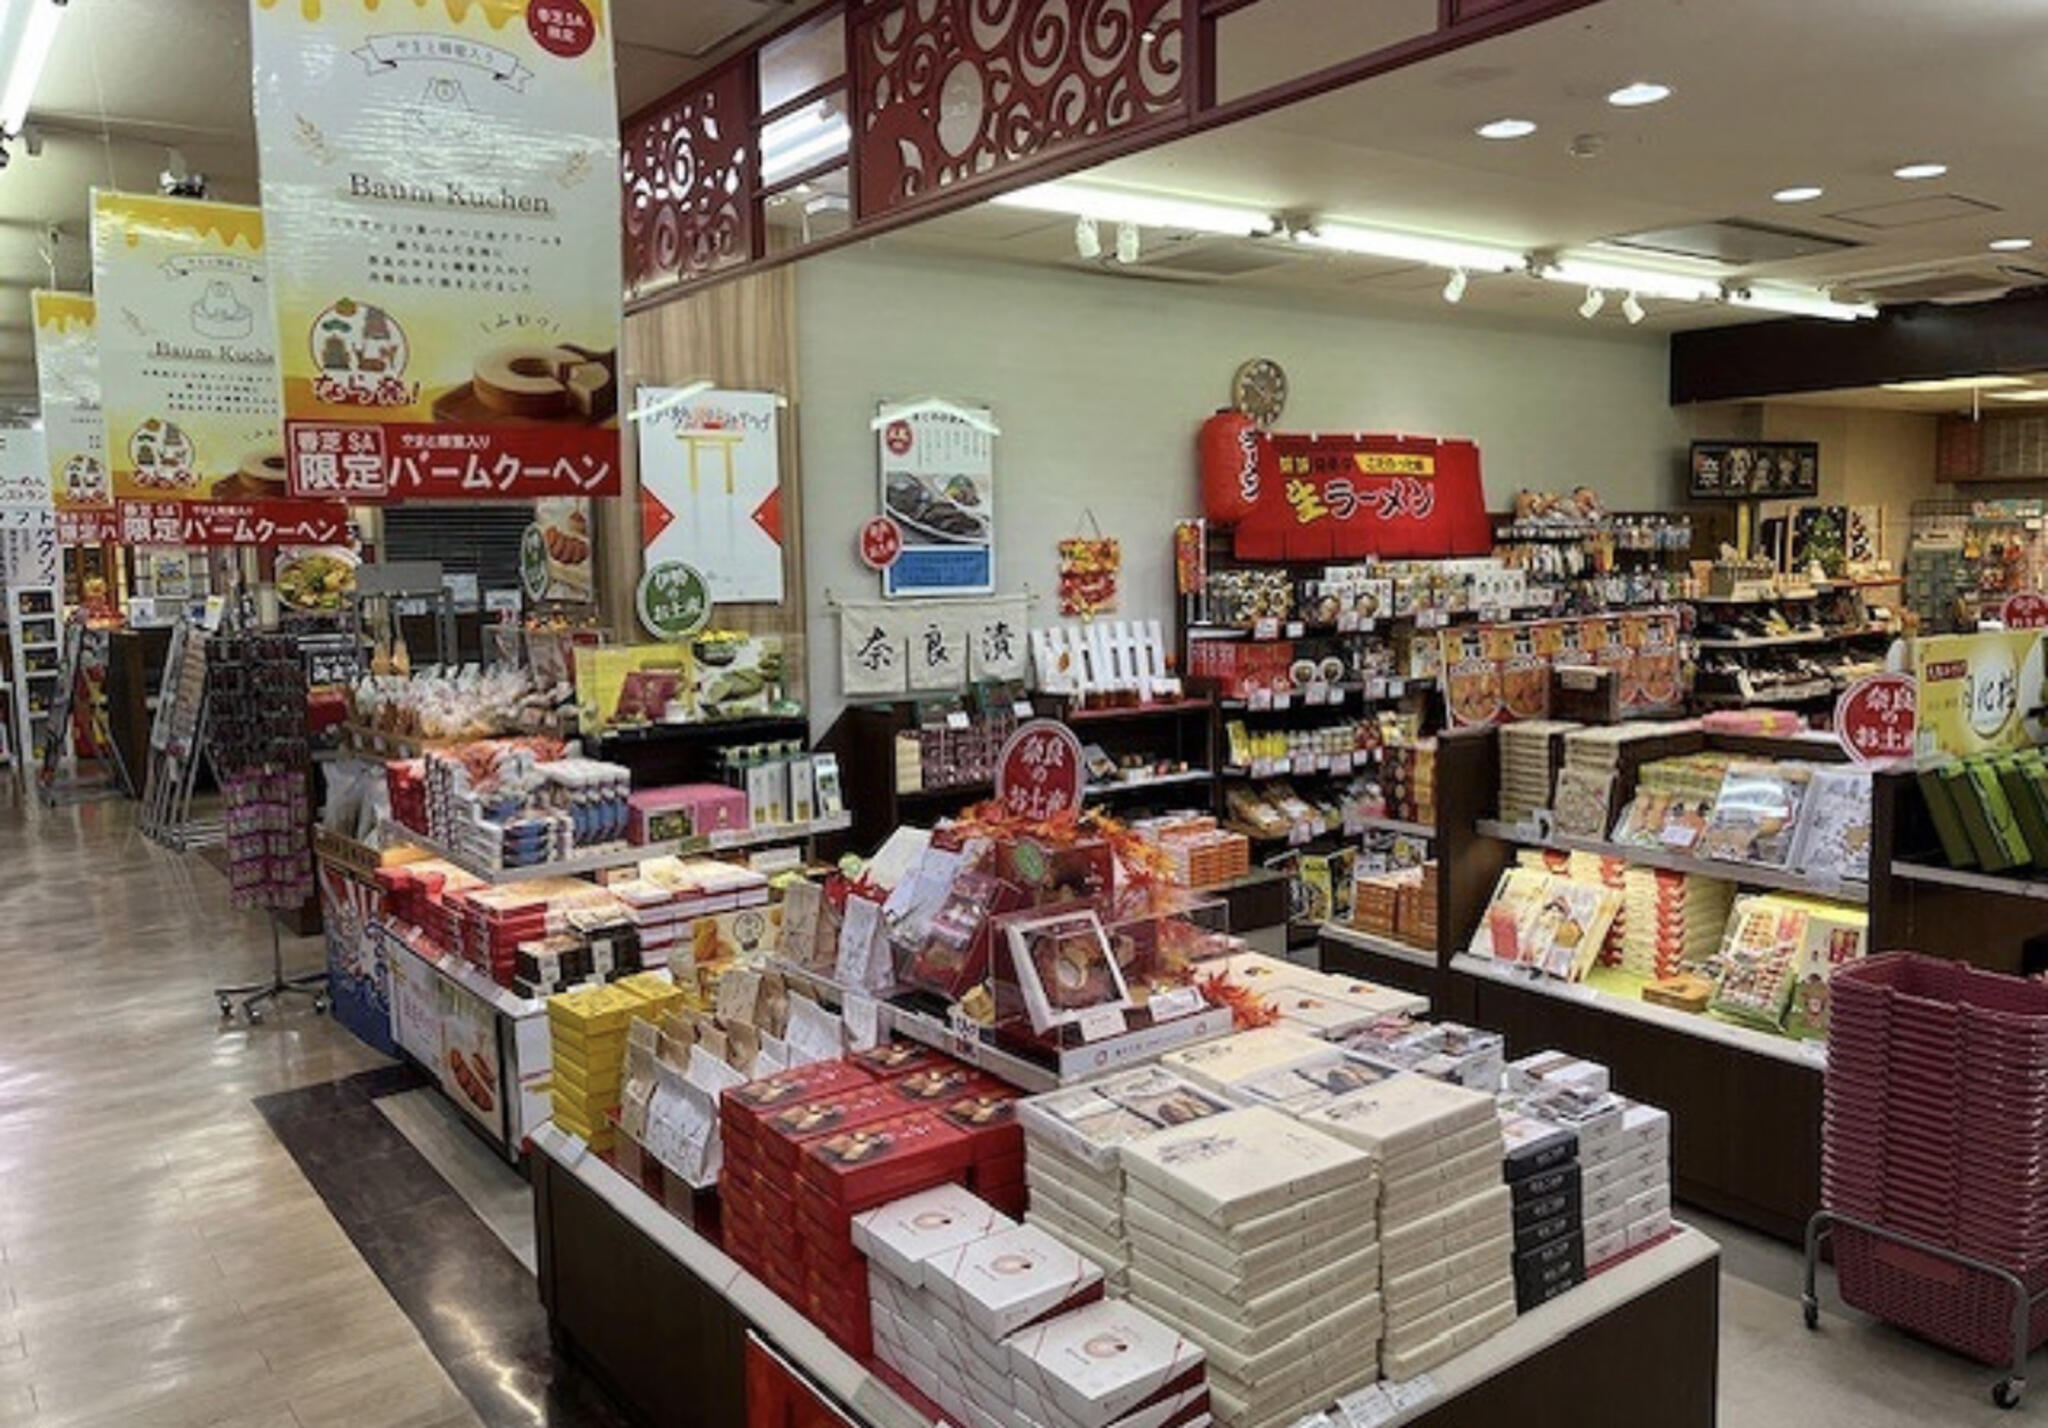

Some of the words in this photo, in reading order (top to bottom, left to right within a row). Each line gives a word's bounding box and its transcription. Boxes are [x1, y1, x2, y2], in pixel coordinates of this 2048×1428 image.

[349, 173, 434, 204] Baum
[446, 182, 550, 214] Kuchen
[155, 341, 212, 360] Baum
[300, 454, 381, 490] 限定
[389, 452, 609, 490] バームクーヘン
[184, 517, 338, 543] バームクーヘン
[857, 619, 1015, 671] 奈良漬
[1022, 735, 1064, 767] 奈良
[1032, 765, 1048, 783] の
